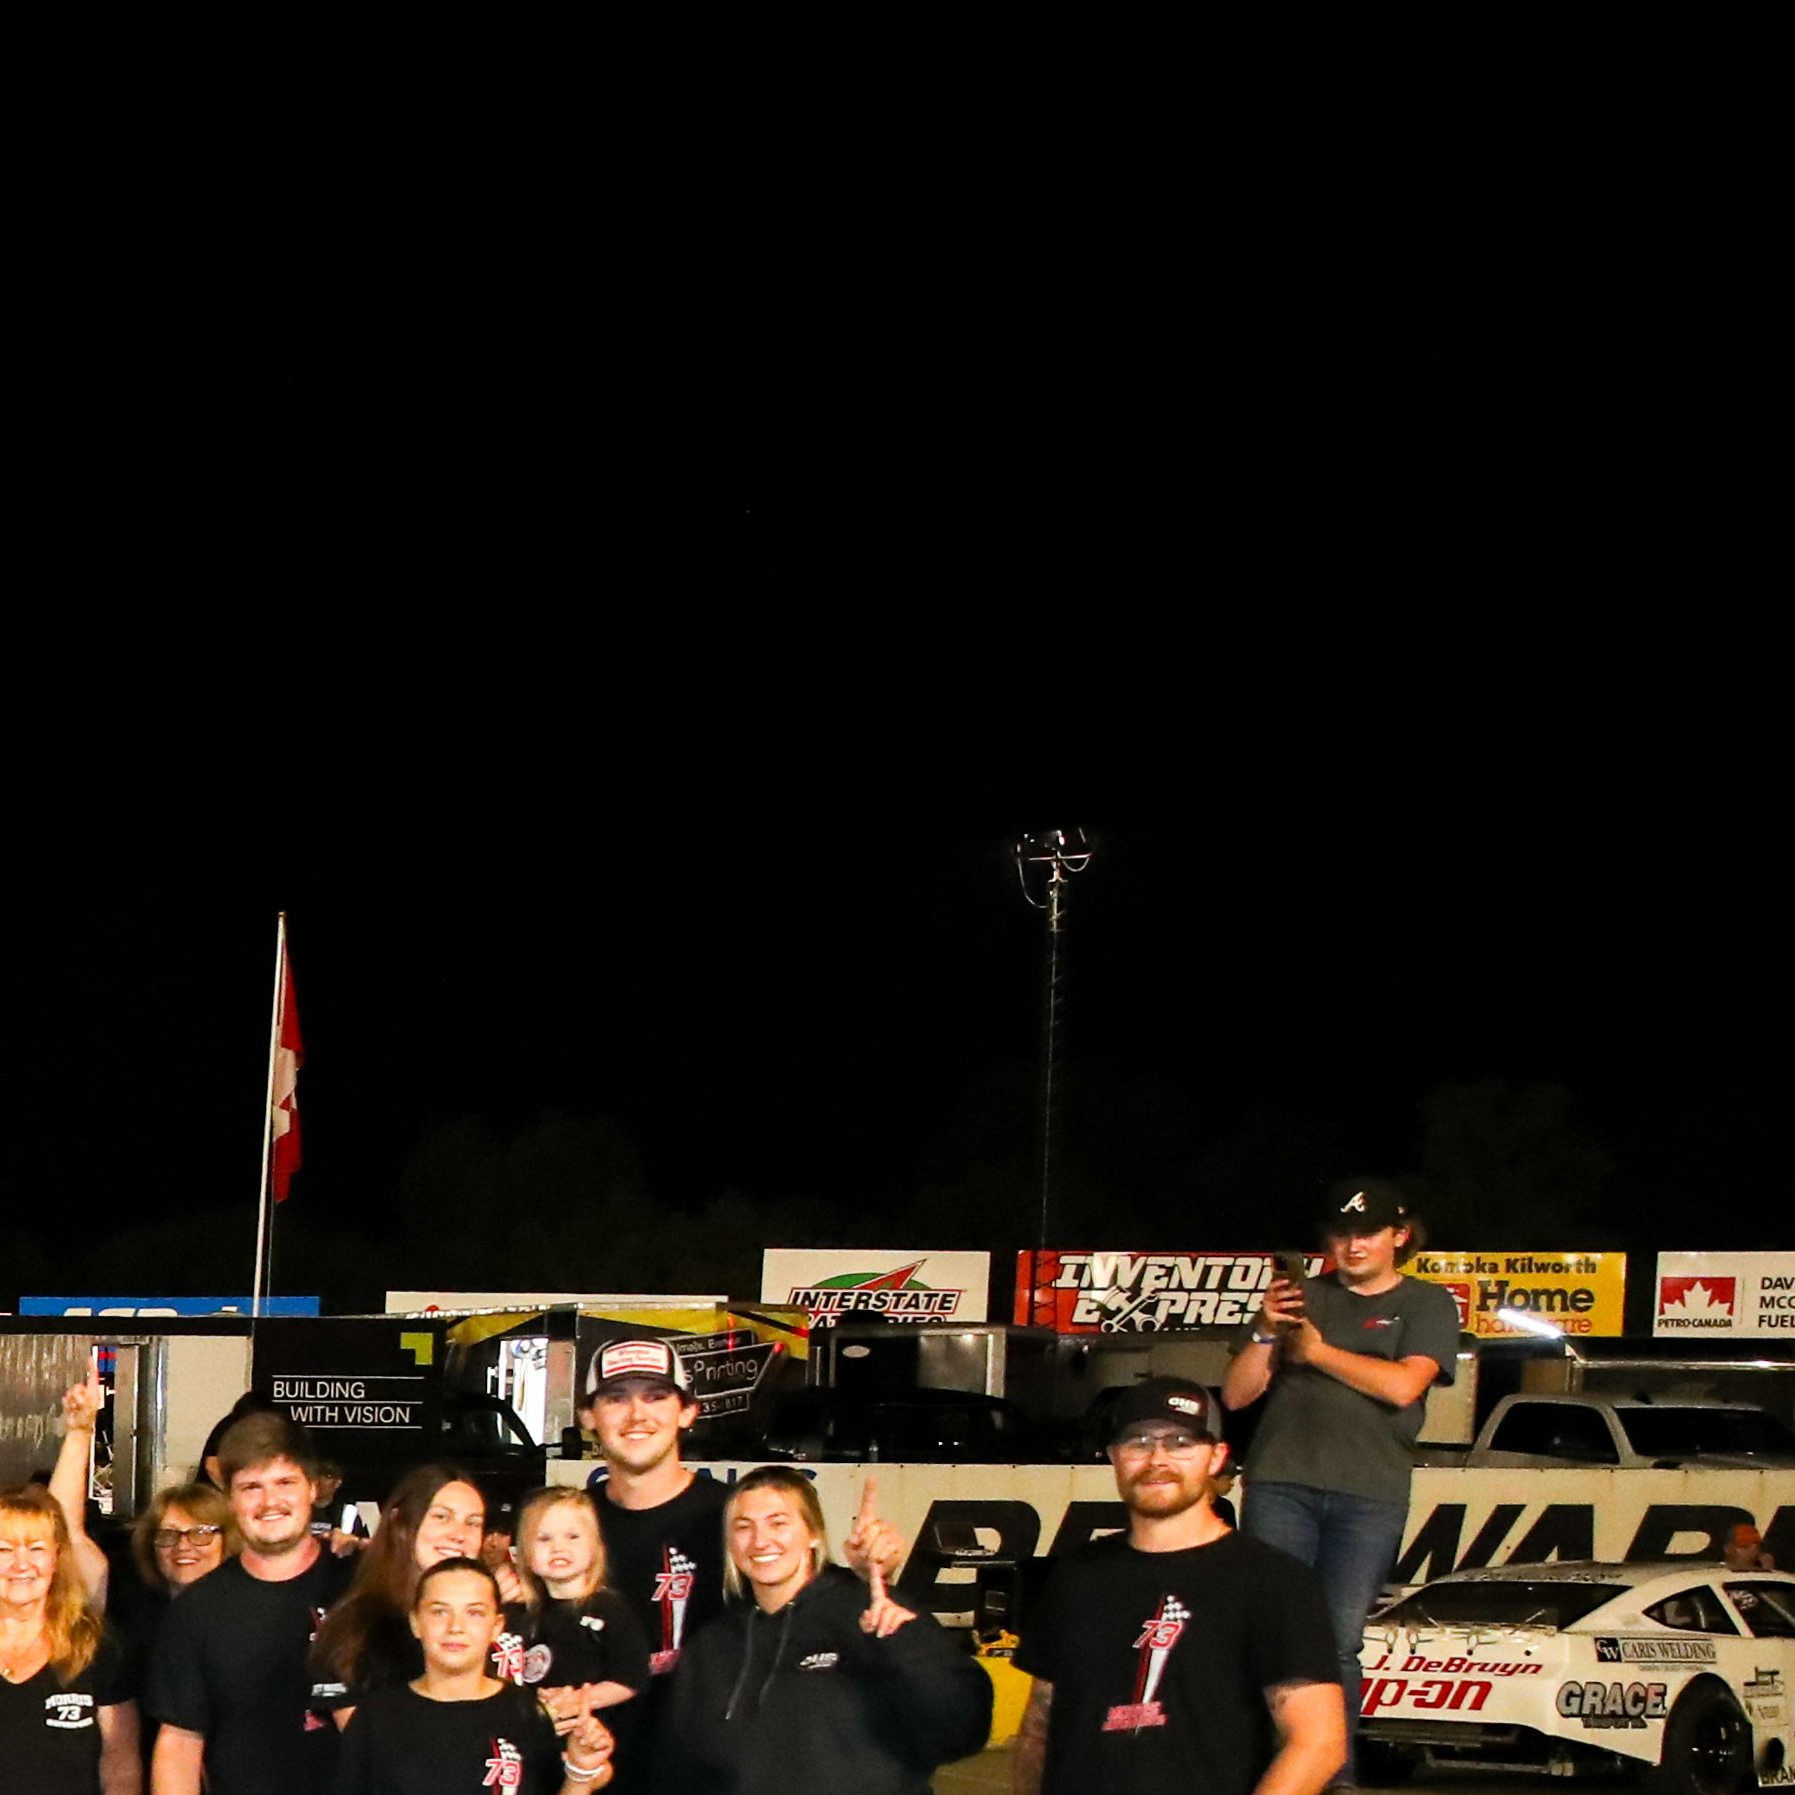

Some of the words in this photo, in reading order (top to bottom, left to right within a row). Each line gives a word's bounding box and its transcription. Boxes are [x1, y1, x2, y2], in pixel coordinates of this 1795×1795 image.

[1052, 1254, 1324, 1290] INVENTO
[1505, 1256, 1597, 1274] Kilworth
[792, 1291, 957, 1312] INTERSTATE
[1476, 1281, 1595, 1311] Home
[1657, 1319, 1733, 1329] PETRO-CANADA
[273, 1382, 365, 1399] BUILDING
[291, 1406, 341, 1423] WITH
[345, 1405, 410, 1423] VISION
[651, 1572, 693, 1602] 73
[1132, 1619, 1183, 1649] 73
[1658, 1641, 1717, 1661] WELDING
[1398, 1657, 1543, 1676] DeBruyn
[1557, 1681, 1667, 1718] GRACE
[57, 1705, 82, 1720] 73
[482, 1758, 522, 1788] 73
